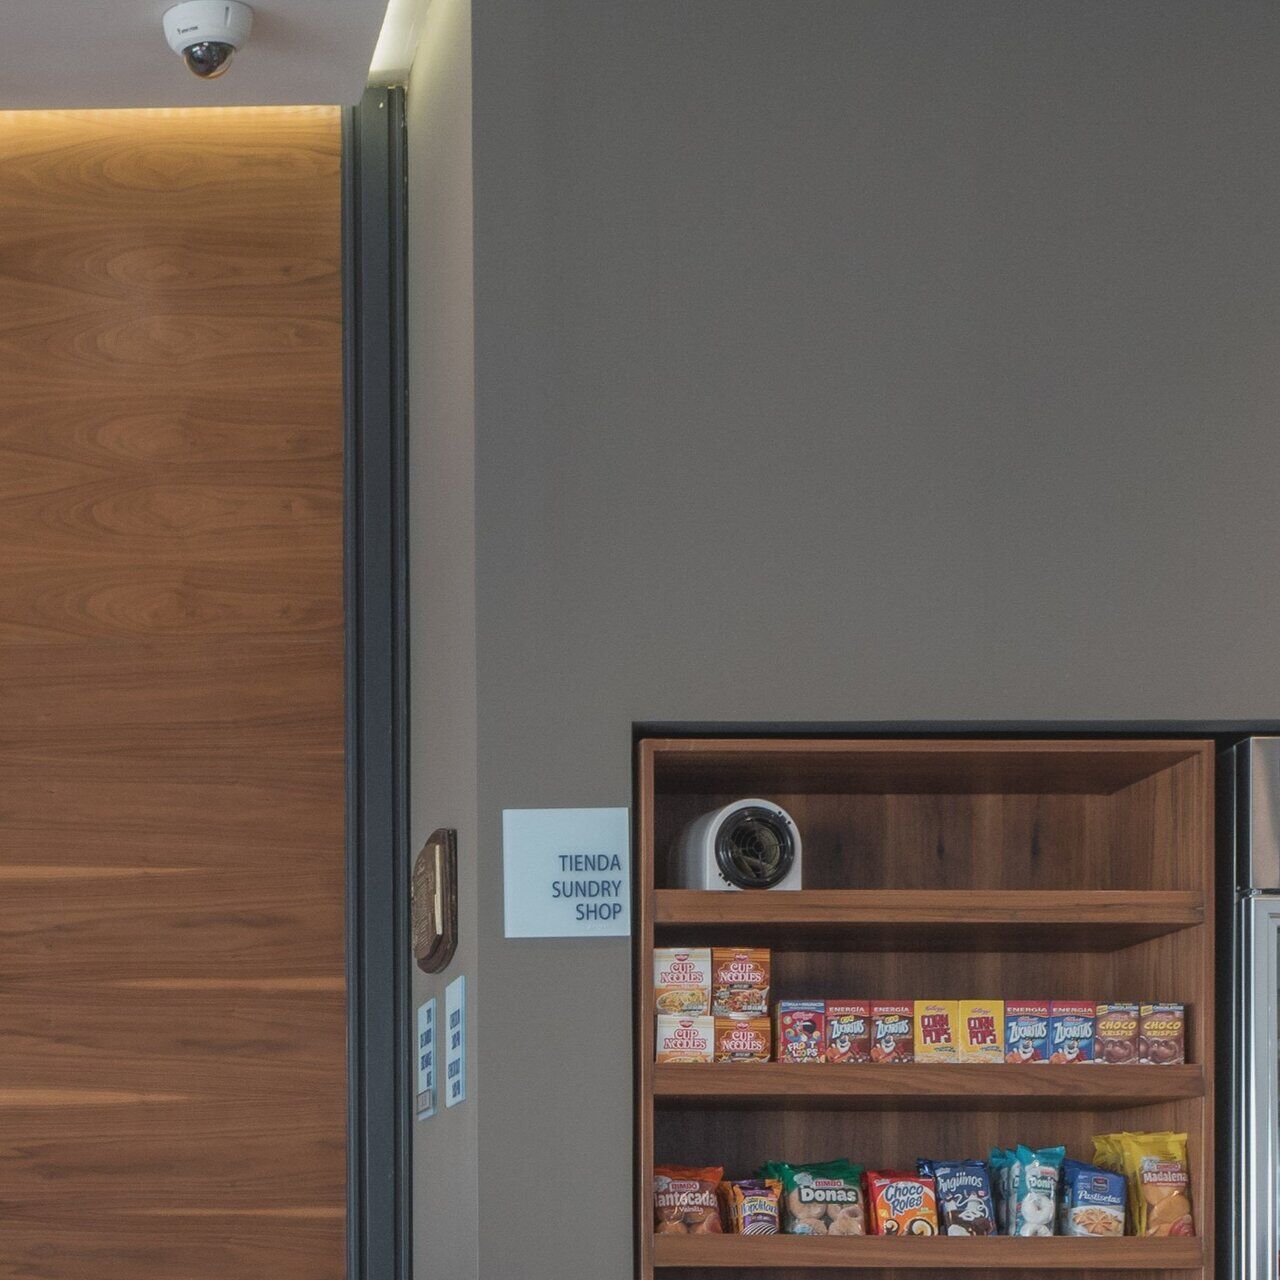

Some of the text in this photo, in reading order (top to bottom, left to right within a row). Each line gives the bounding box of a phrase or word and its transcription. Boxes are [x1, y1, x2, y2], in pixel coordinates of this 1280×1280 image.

[558, 853, 621, 871] TIENDA
[552, 880, 621, 898] SUNDRY
[576, 903, 622, 920] SHOP
[670, 963, 695, 974] CUP
[730, 963, 754, 972] CUP
[660, 972, 704, 983] NOODLES
[720, 972, 763, 982] NOODLES
[1099, 1021, 1137, 1030] CHOCO
[1144, 1021, 1182, 1030] CHOCO
[674, 1029, 699, 1040] CUP
[731, 1031, 755, 1041] CUP
[664, 1038, 707, 1049] NOODLES
[722, 1040, 763, 1051] NOODLES
[800, 1187, 857, 1202] Donas
[885, 1184, 924, 1201] Choco
[891, 1196, 923, 1217] Roles
